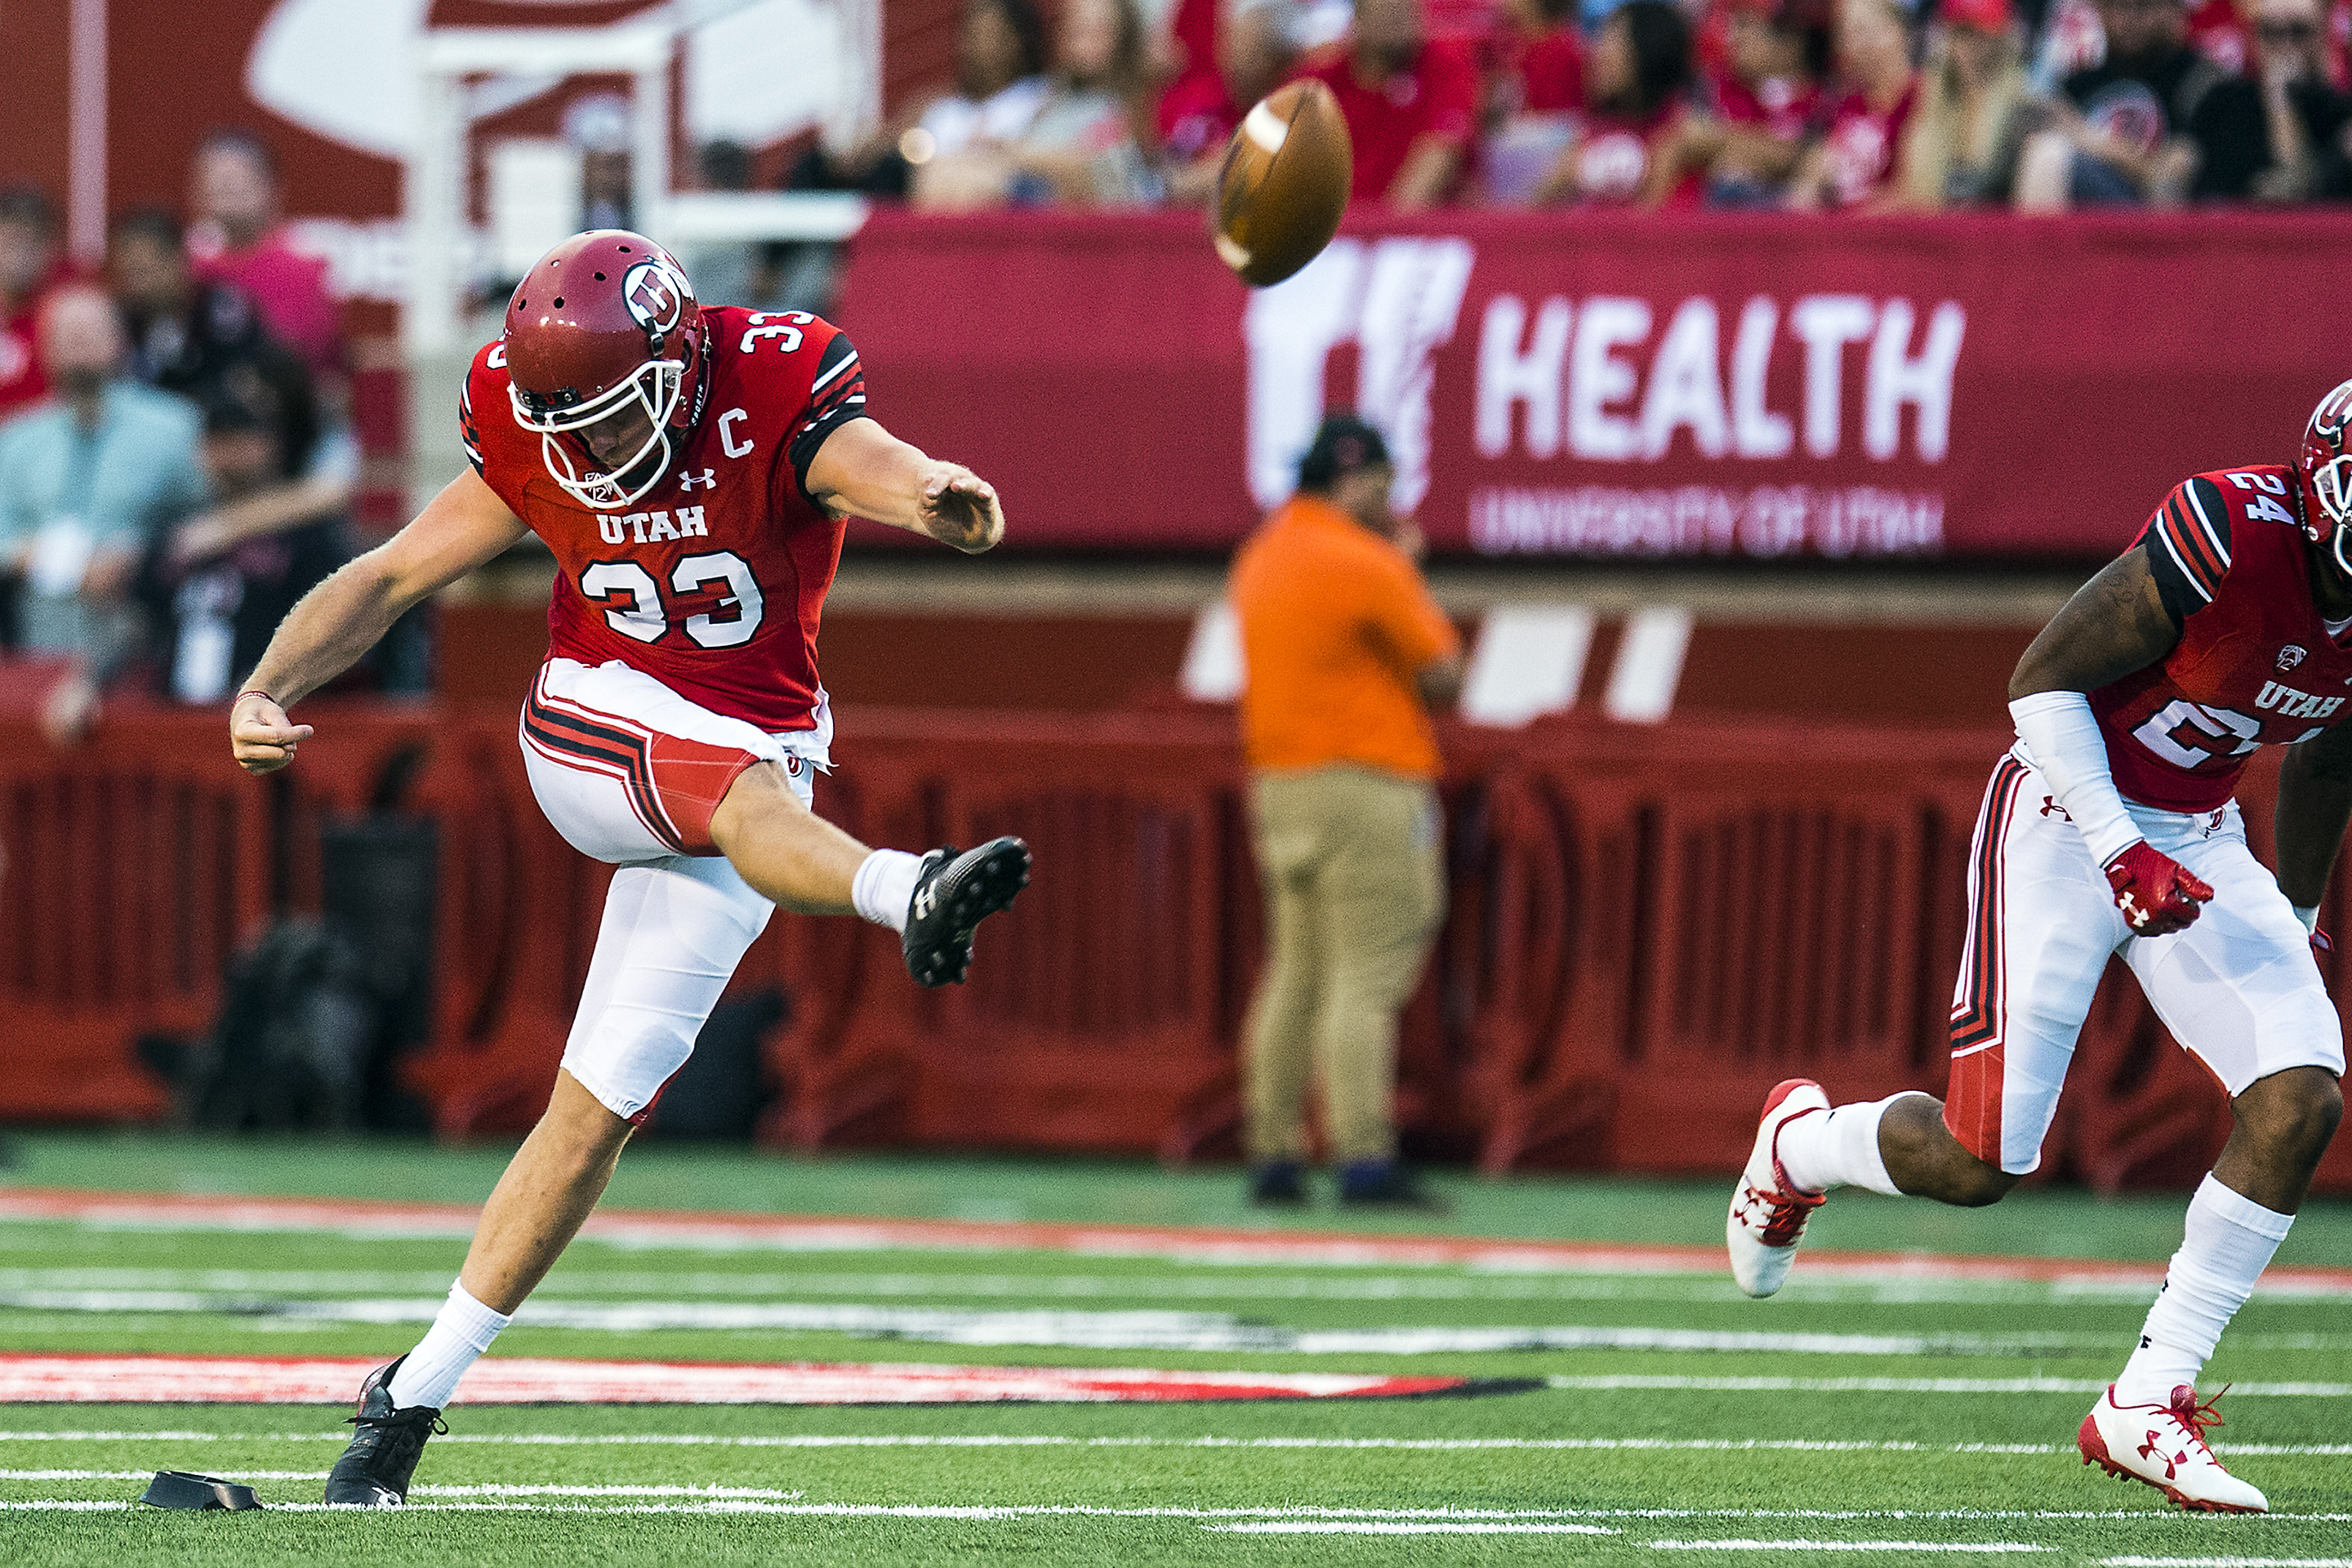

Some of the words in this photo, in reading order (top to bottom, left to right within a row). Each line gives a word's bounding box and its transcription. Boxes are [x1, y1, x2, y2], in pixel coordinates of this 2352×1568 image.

[1473, 295, 1967, 462] HEALTH
[718, 408, 755, 459] C
[596, 505, 709, 545] UTAH
[1469, 485, 1738, 559] UNIVERSITY
[1740, 485, 1808, 559] OF
[1811, 485, 1945, 559] UTAH
[2224, 471, 2296, 526] 24
[577, 548, 765, 650] 33
[2255, 680, 2345, 718] UTAH
